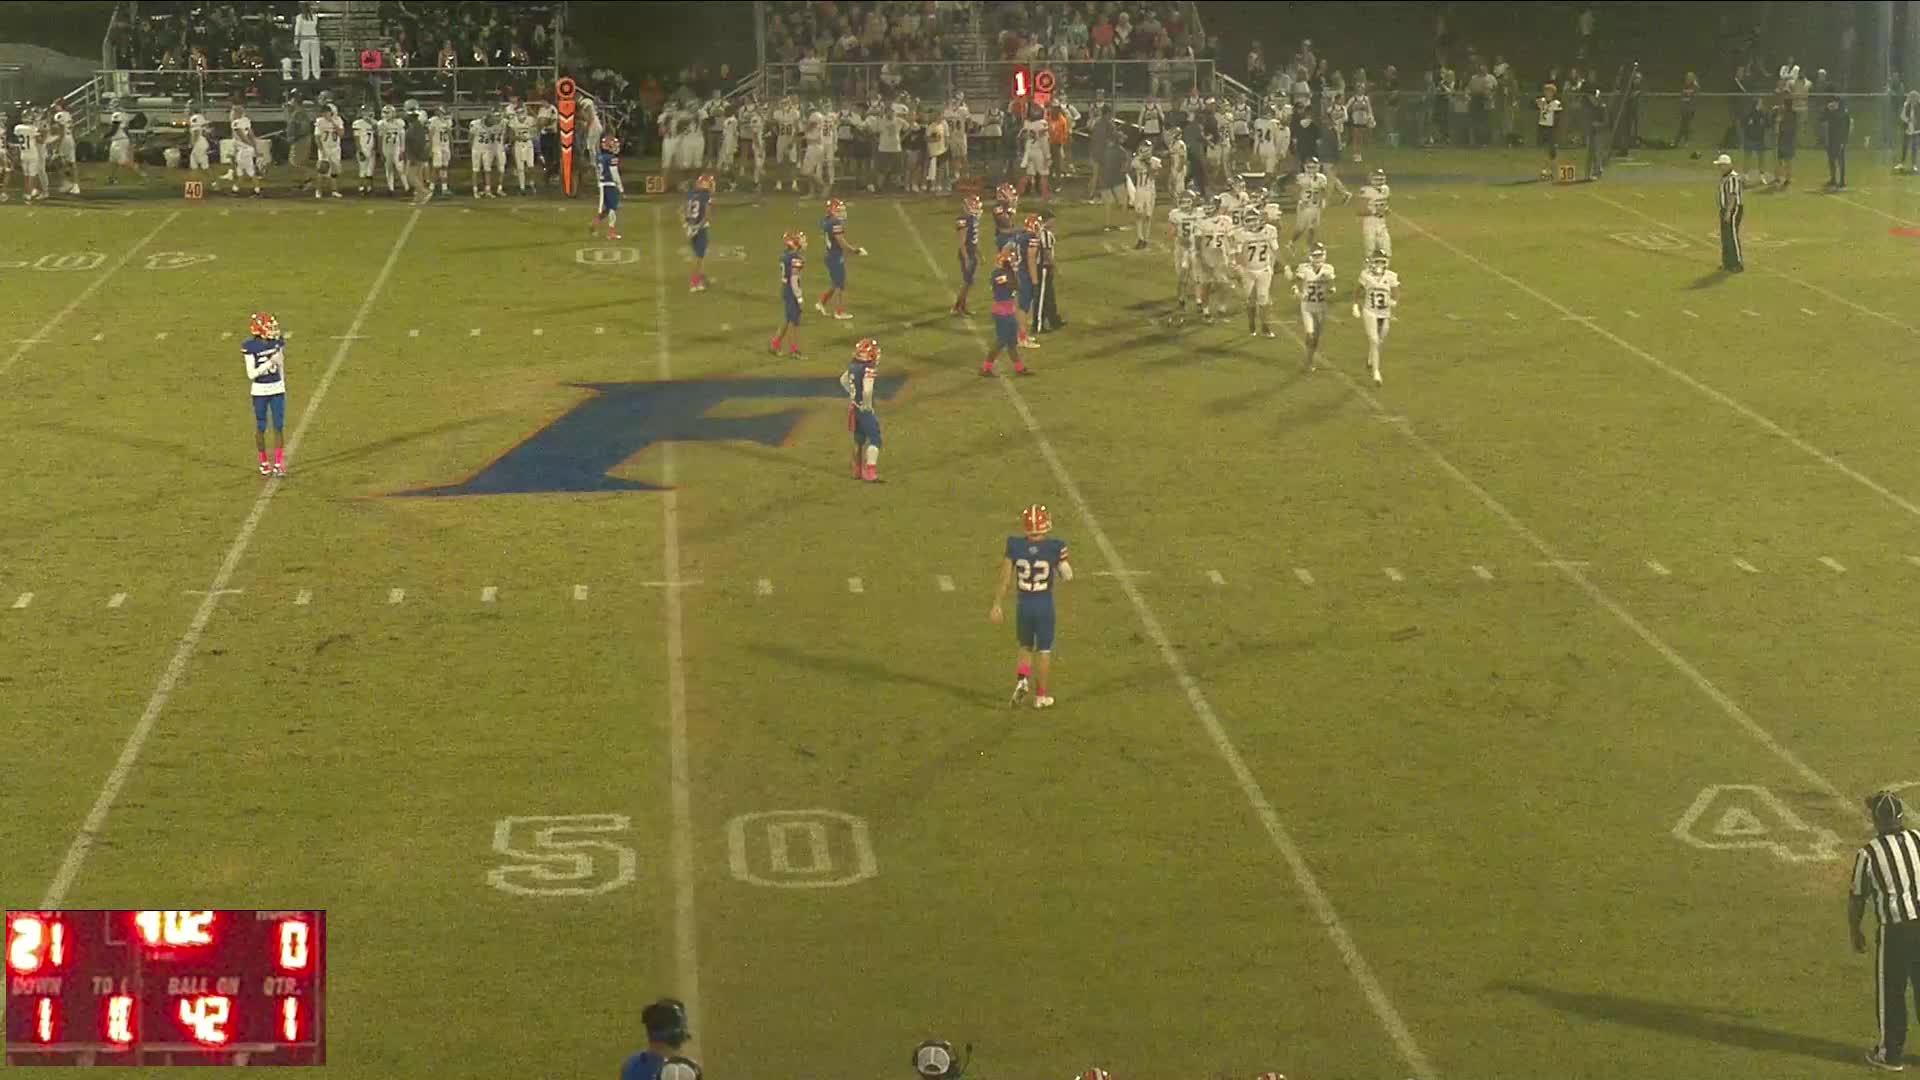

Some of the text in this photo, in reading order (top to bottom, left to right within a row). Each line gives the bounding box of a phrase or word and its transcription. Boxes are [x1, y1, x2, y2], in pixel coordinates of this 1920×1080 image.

[1015, 71, 1027, 96] 1
[1560, 167, 1575, 180] 30
[187, 183, 201, 197] 40
[1206, 234, 1223, 248] 75
[1248, 245, 1268, 262] 72
[1369, 293, 1386, 309] 13
[1016, 559, 1049, 591] 22
